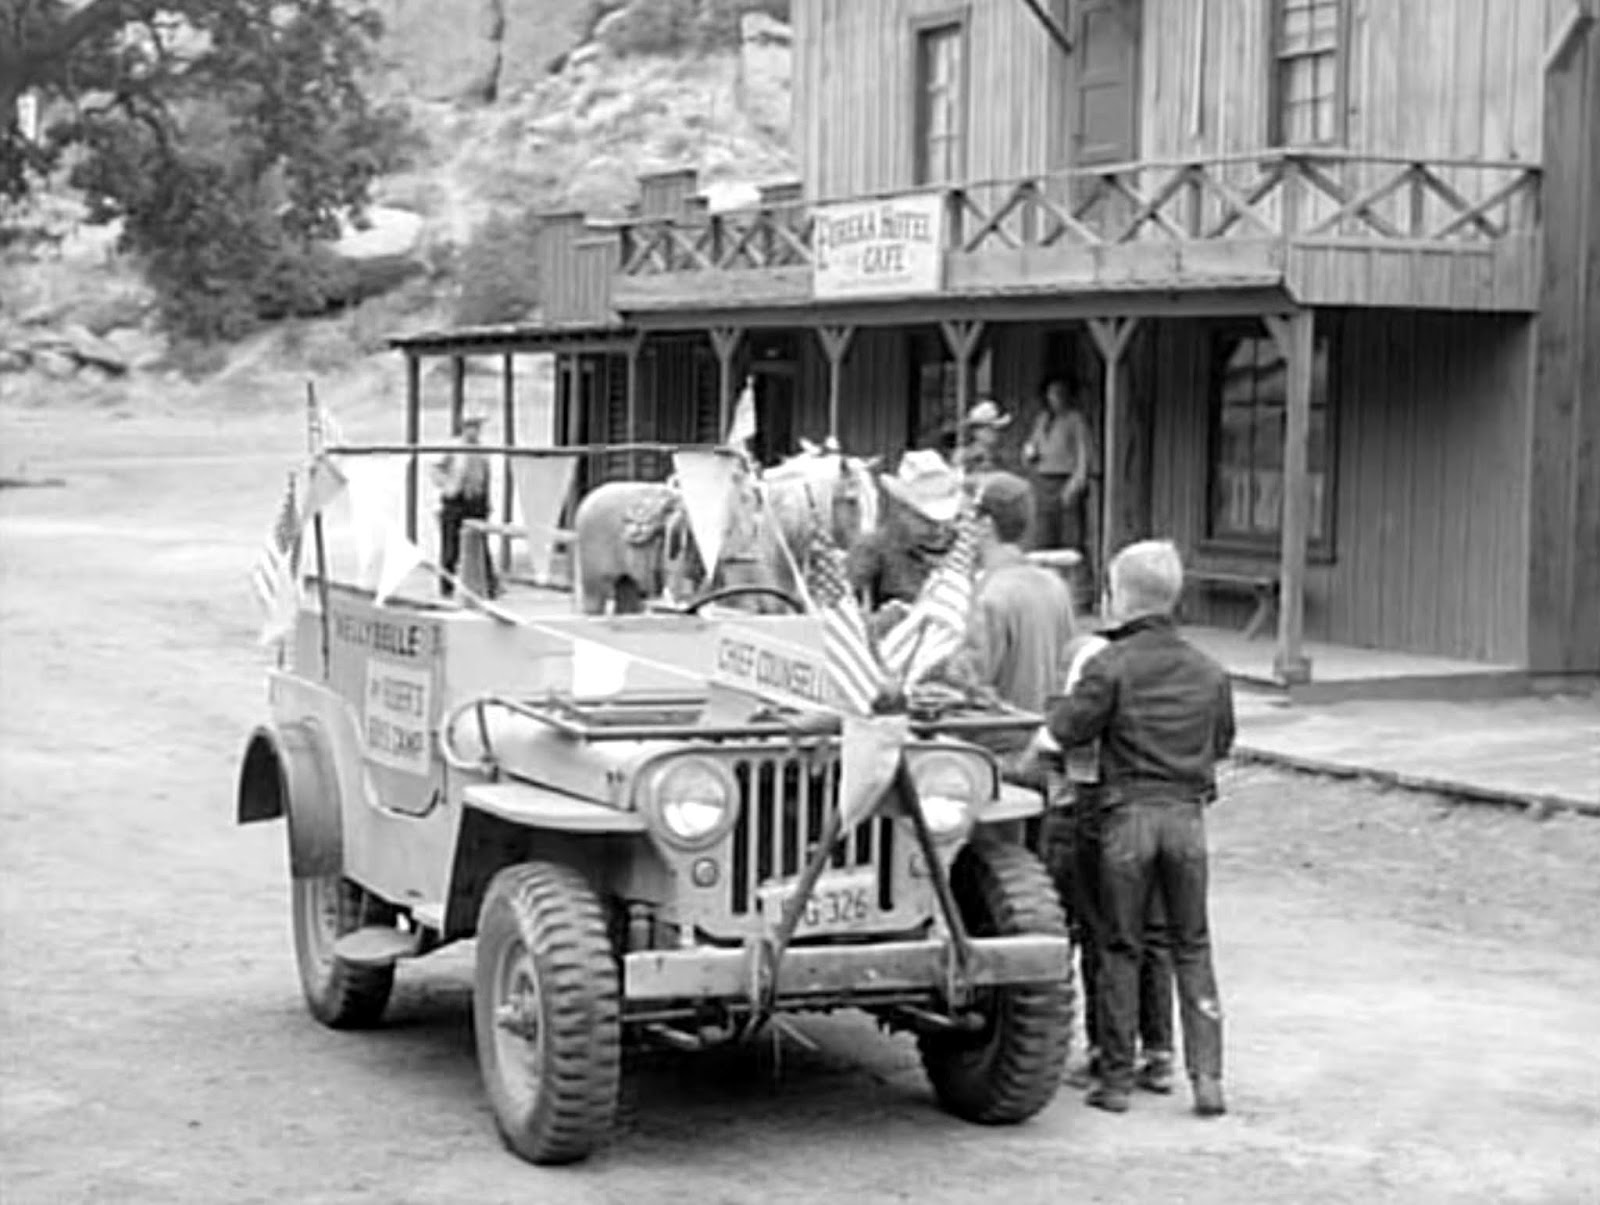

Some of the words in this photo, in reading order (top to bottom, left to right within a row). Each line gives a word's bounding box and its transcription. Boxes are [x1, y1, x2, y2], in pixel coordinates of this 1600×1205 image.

[863, 243, 905, 274] CAFE
[718, 637, 755, 677] CHIEF
[826, 888, 868, 922] 326
